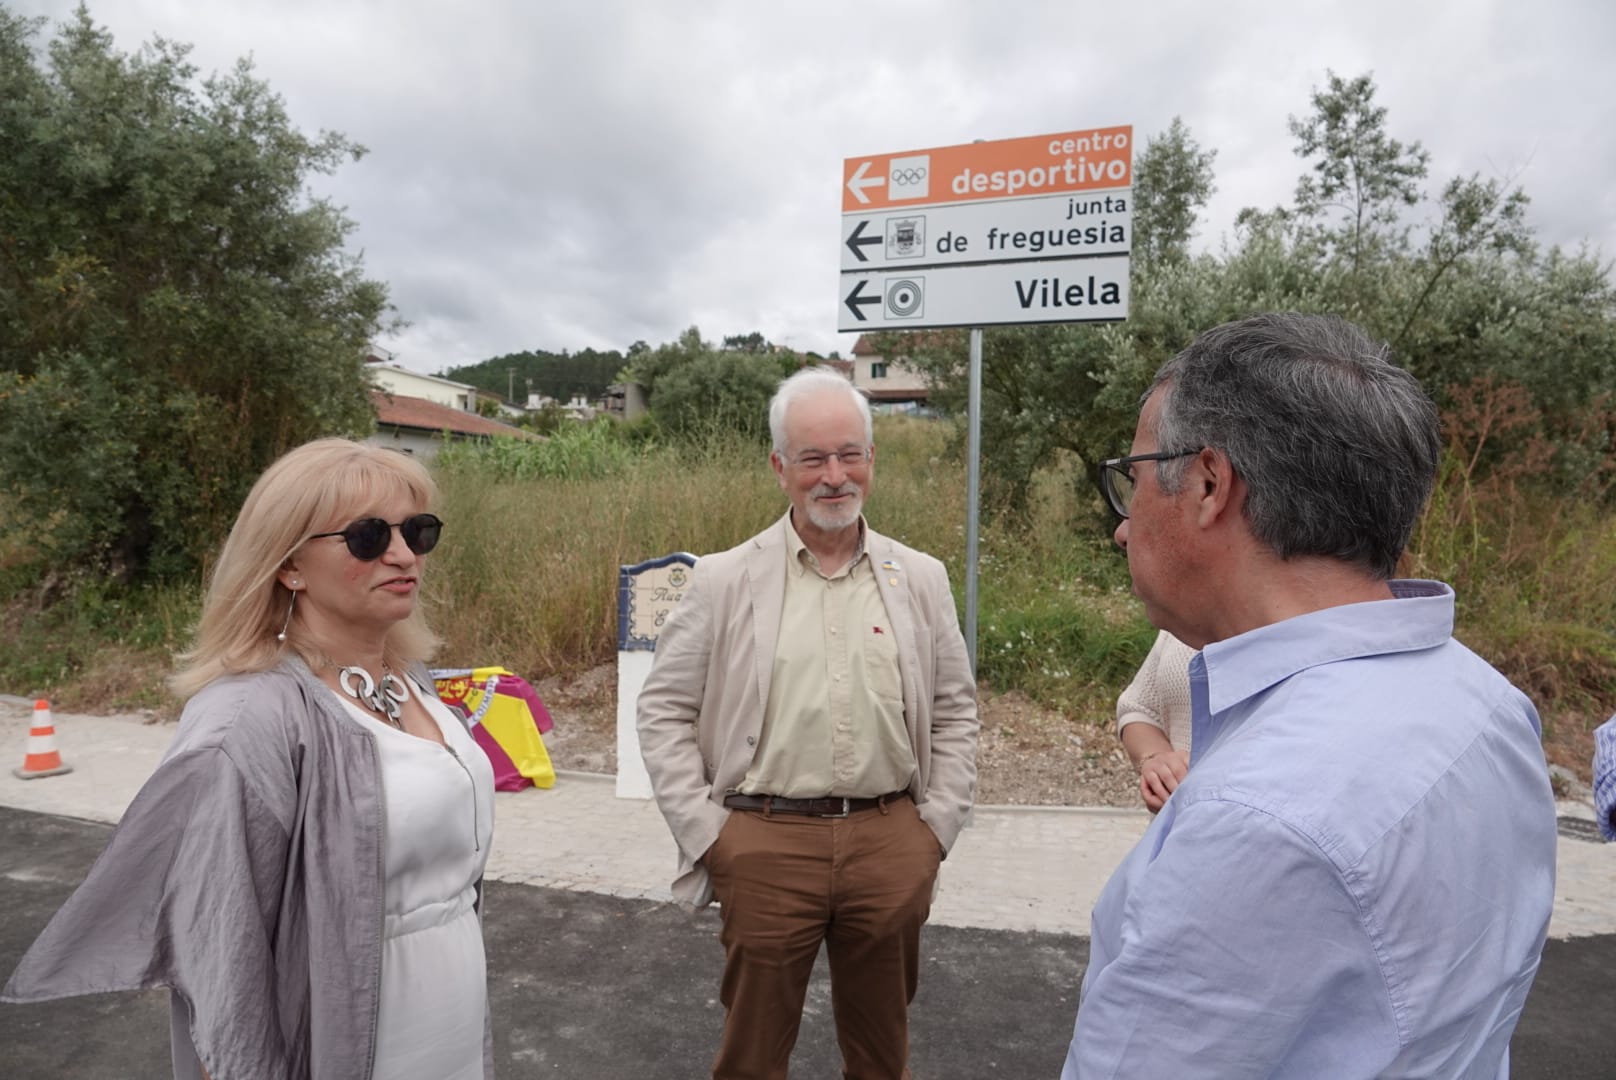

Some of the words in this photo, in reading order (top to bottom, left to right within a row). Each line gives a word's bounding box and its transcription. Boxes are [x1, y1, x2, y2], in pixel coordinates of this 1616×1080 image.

[1049, 132, 1127, 156] centro
[952, 157, 1126, 194] desportivo
[1066, 196, 1126, 220] junta
[936, 231, 968, 253] de
[987, 220, 1125, 252] freguesia
[1015, 276, 1121, 309] Vilela
[650, 587, 682, 602] Rua
[472, 679, 496, 722] COIMBR
